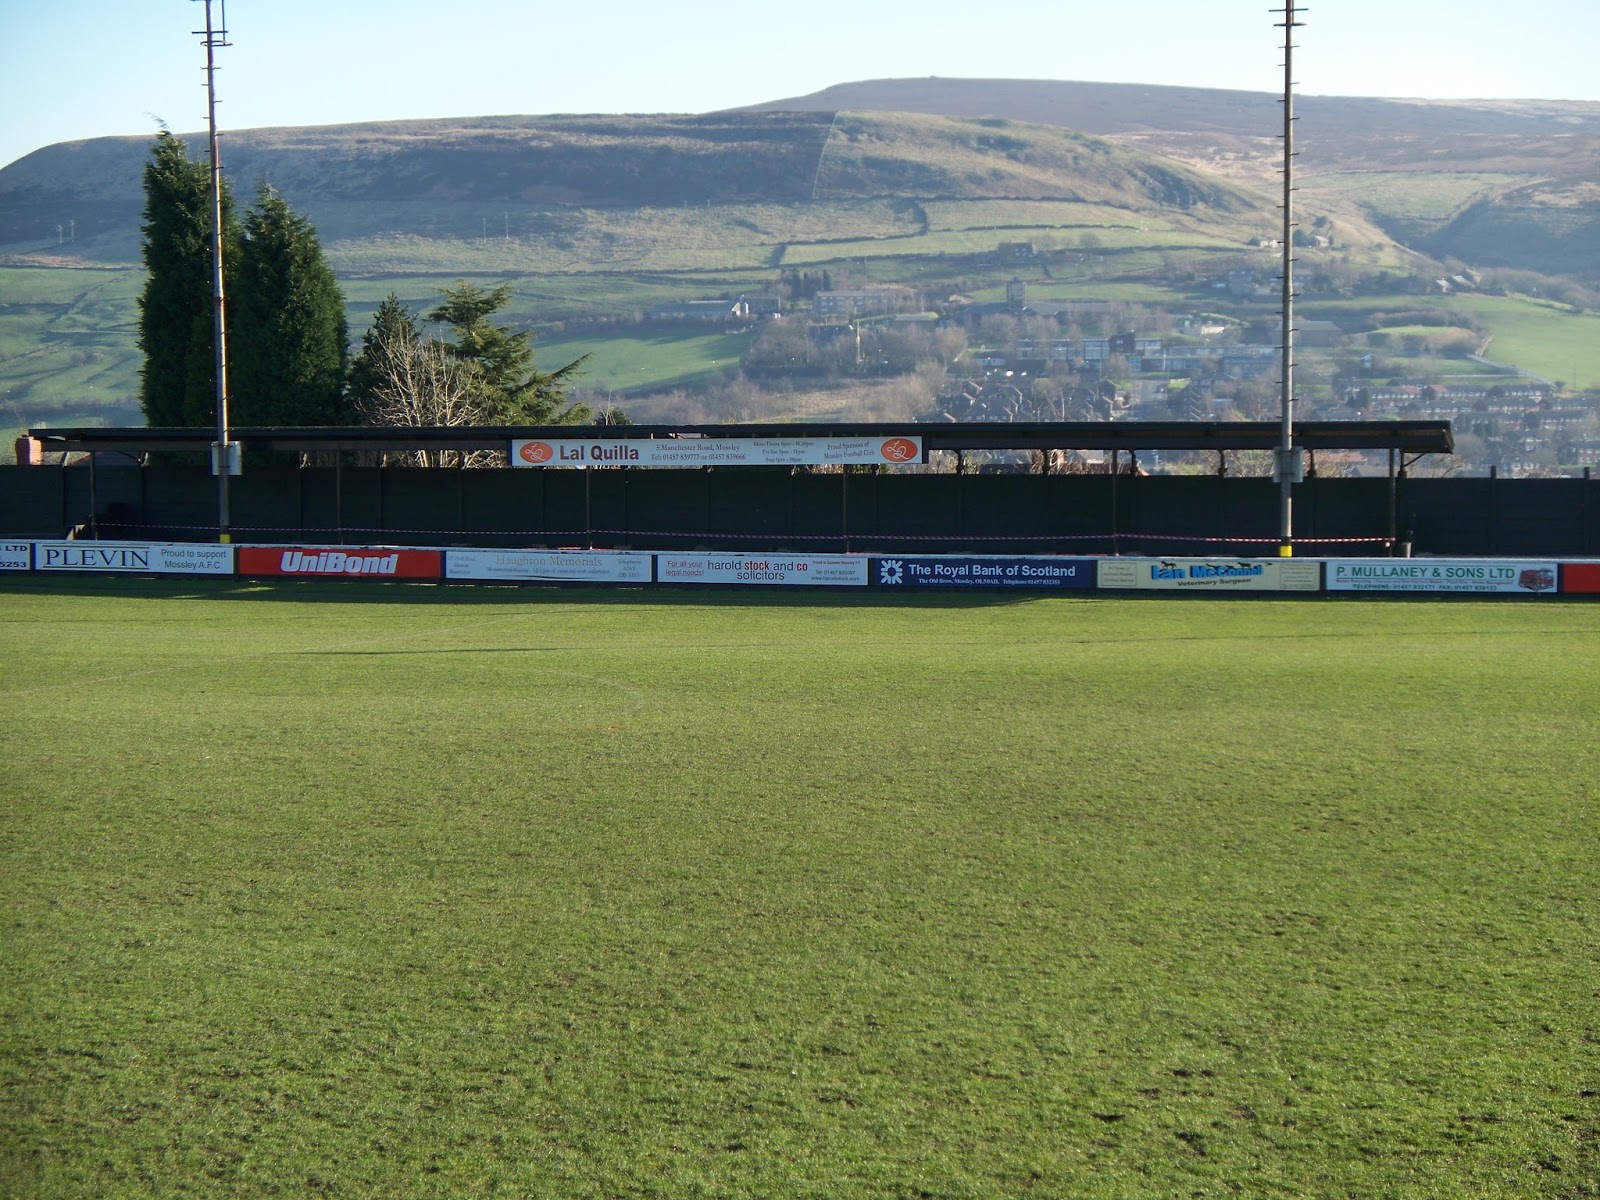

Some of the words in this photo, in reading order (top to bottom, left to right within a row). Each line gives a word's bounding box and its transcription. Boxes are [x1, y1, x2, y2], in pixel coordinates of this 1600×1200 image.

[560, 445, 585, 461] Lal
[590, 445, 639, 462] Quilla
[715, 444, 740, 452] Mossley
[651, 453, 662, 461] Tel:
[662, 453, 679, 461] 01457
[680, 453, 700, 461] 839777
[708, 453, 725, 461] 01457
[45, 549, 150, 567] PLEVIN
[161, 549, 185, 557] Proud
[187, 550, 195, 558] to
[197, 551, 227, 561] support
[496, 554, 546, 567] Haughton
[550, 555, 602, 567] Memorials
[164, 560, 197, 570] Mossley
[198, 561, 223, 570] A.F.C.
[280, 551, 399, 574] UniBond
[688, 561, 703, 569] your
[707, 559, 741, 570] harold
[744, 560, 770, 571] stock
[773, 561, 794, 571] and
[796, 563, 808, 571] co
[736, 570, 785, 581] solicitors
[908, 564, 932, 575] The
[935, 564, 969, 578] Royal
[972, 565, 1003, 576] Bank
[1006, 565, 1020, 576] of
[1021, 565, 1076, 577] Scotland
[1151, 565, 1187, 580] Ian
[1336, 566, 1347, 577] P.
[1351, 567, 1428, 578] MULLANEY
[1432, 567, 1441, 578] &
[1445, 567, 1485, 579] SONS
[1489, 568, 1516, 579] LTD
